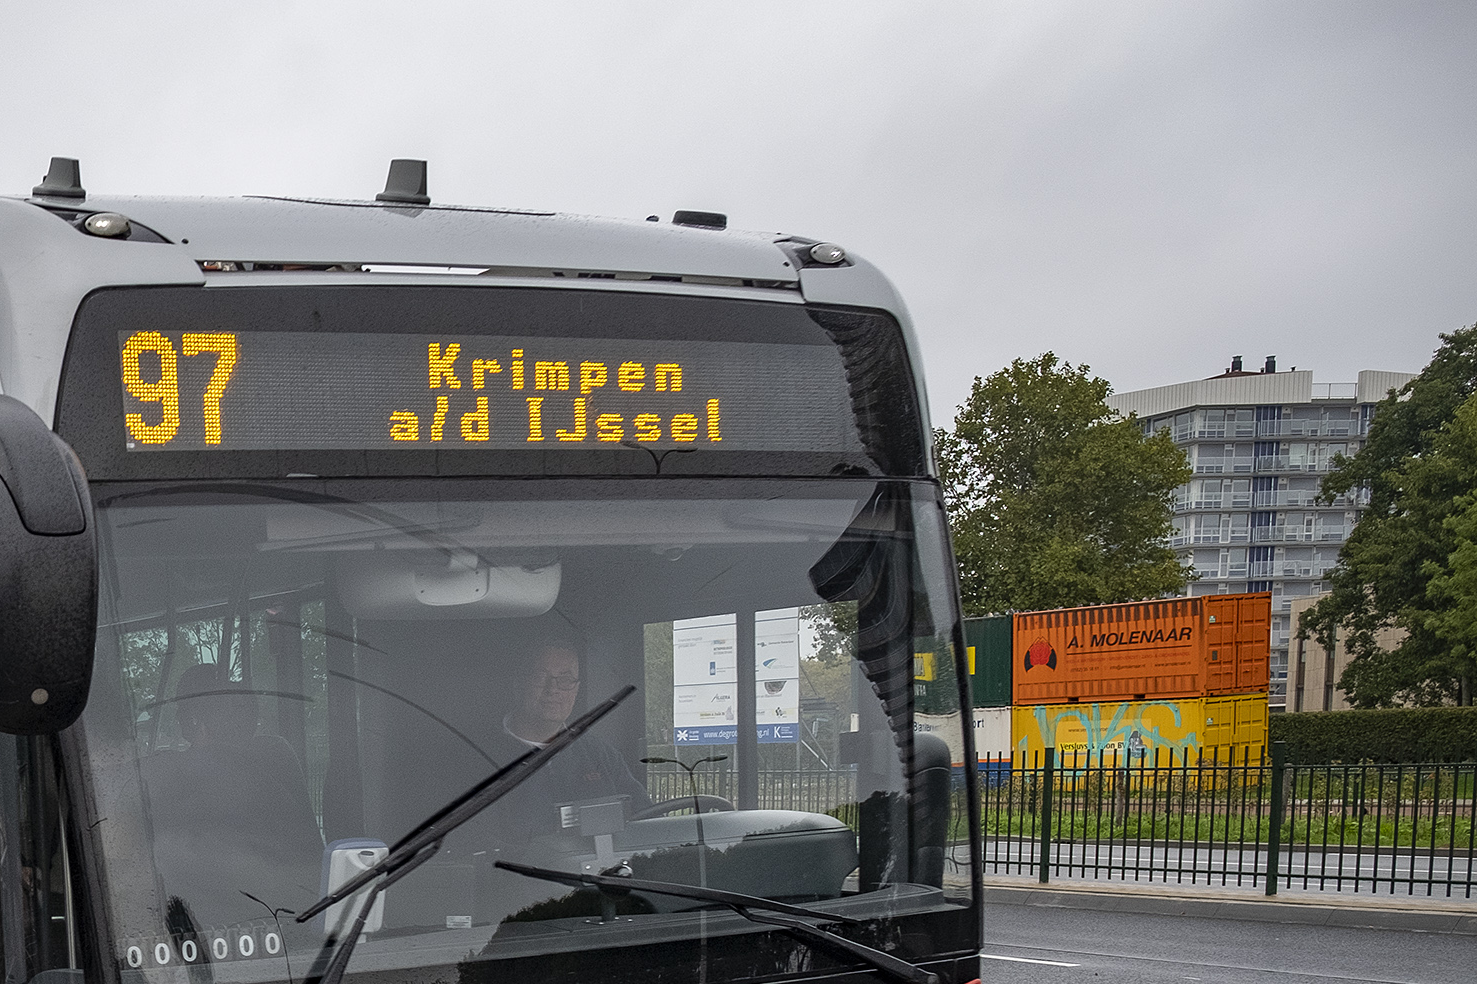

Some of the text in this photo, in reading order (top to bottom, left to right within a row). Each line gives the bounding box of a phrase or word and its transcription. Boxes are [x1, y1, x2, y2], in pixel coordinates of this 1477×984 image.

[122, 331, 237, 445] 97
[428, 342, 683, 394] Krimpen
[388, 396, 723, 442] a/d IJssel
[1067, 627, 1192, 649] A. MOLENAAR
